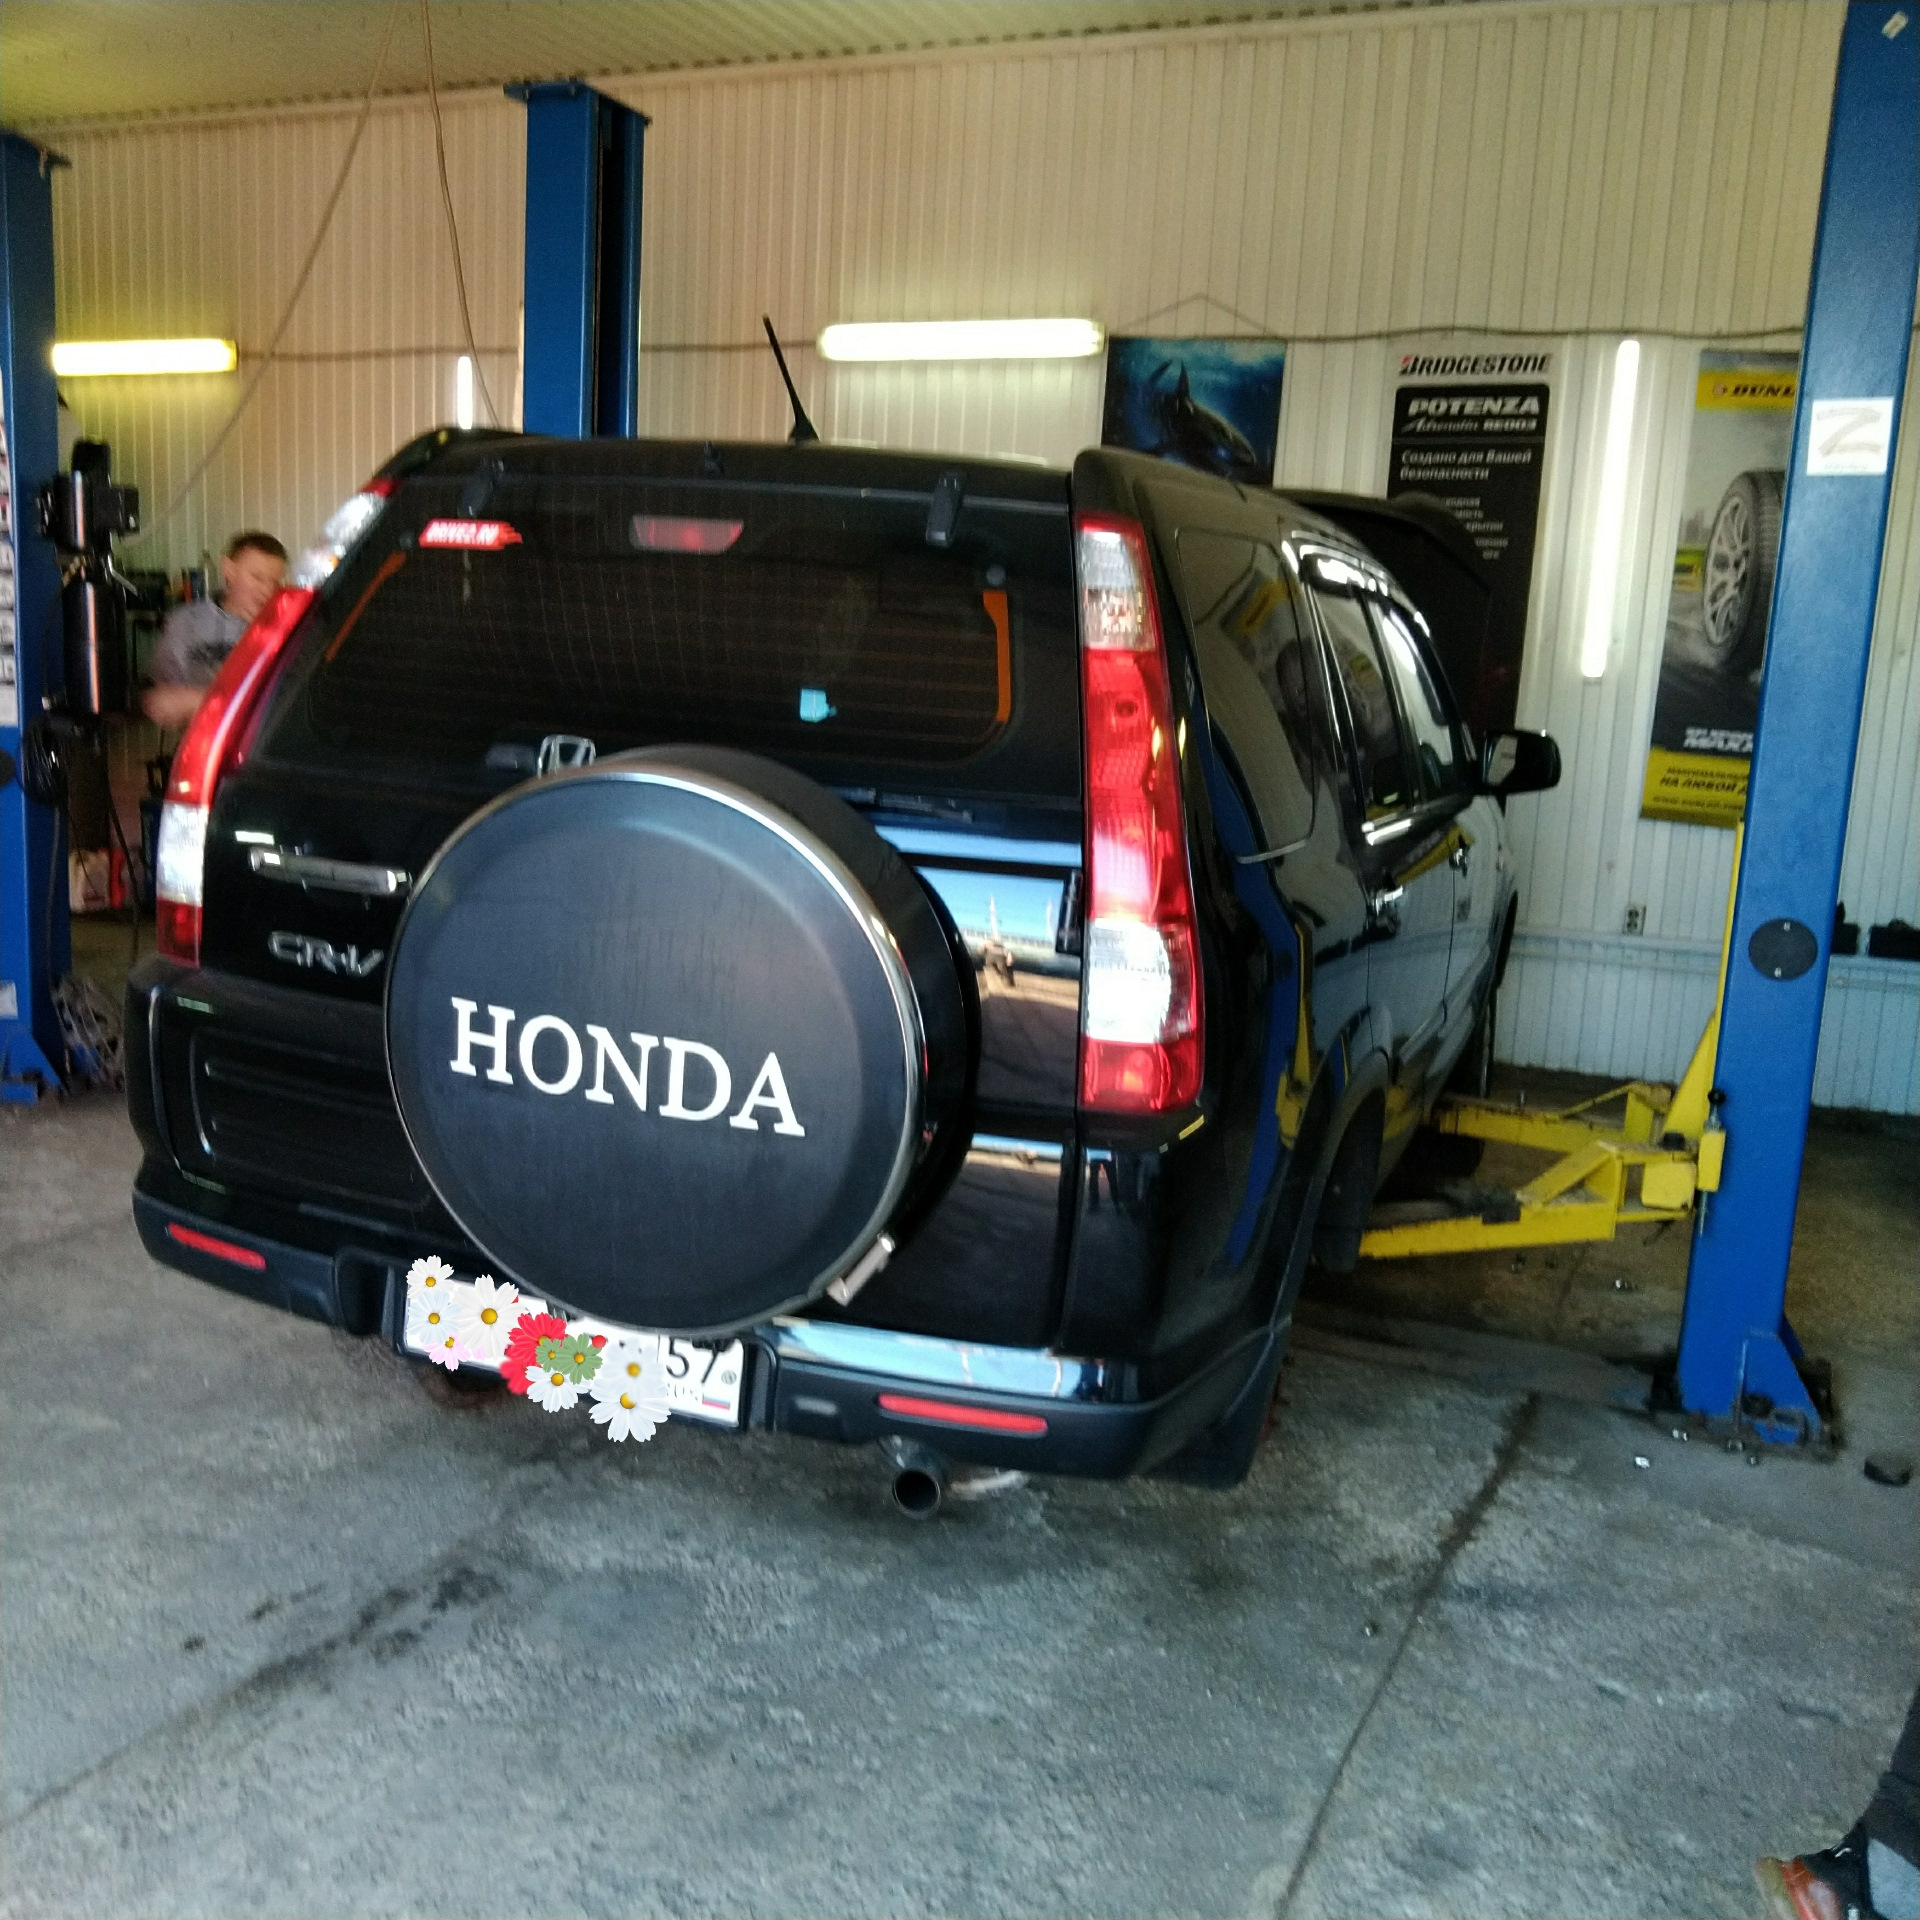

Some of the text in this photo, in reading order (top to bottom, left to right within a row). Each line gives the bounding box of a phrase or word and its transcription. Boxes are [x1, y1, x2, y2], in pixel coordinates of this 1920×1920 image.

[1400, 354, 1551, 376] BRIDGESTONE
[1732, 383, 1796, 397] DUNL
[1408, 396, 1540, 416] POTENZA
[1401, 449, 1456, 465] Создано
[1457, 451, 1484, 465] для
[449, 996, 806, 1137] HONDA
